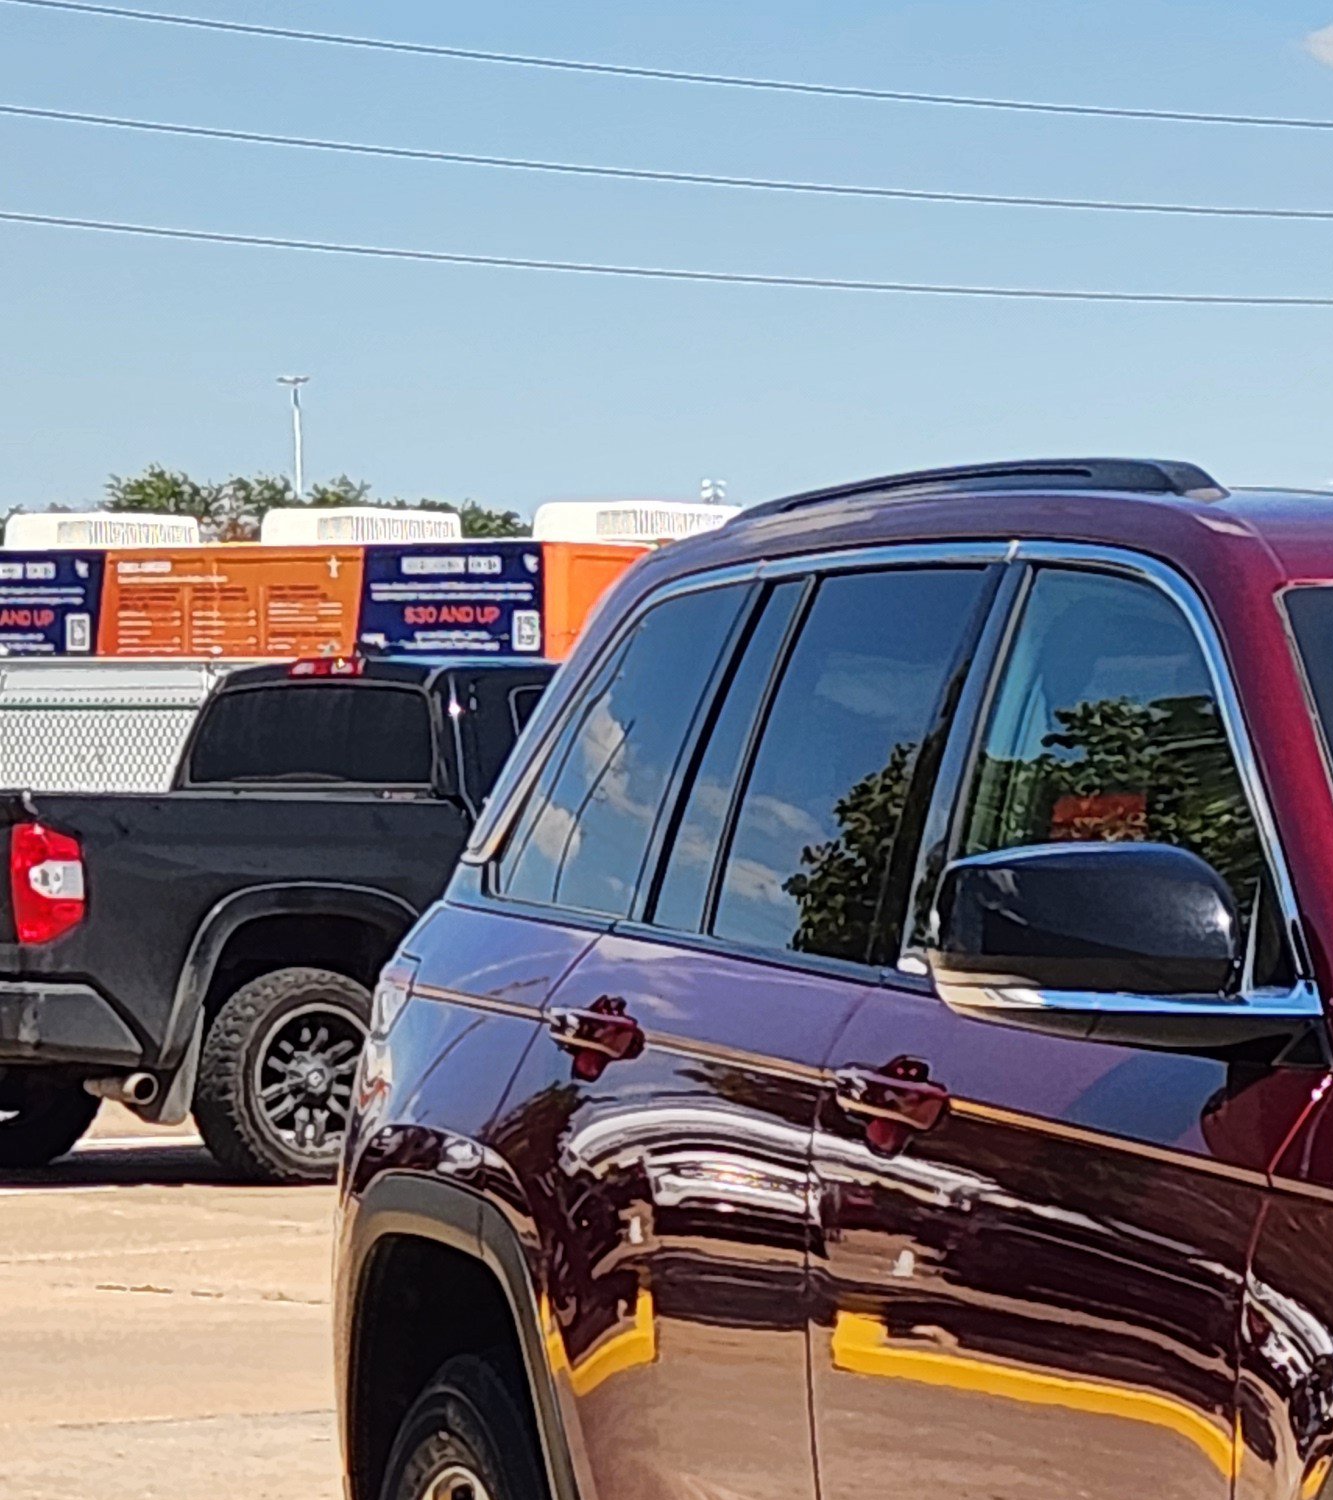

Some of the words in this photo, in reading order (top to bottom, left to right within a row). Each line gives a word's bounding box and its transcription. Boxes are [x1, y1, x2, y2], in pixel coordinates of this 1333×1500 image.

[33, 609, 54, 627] UP
[439, 605, 474, 623] AND
[476, 606, 500, 623] UP
